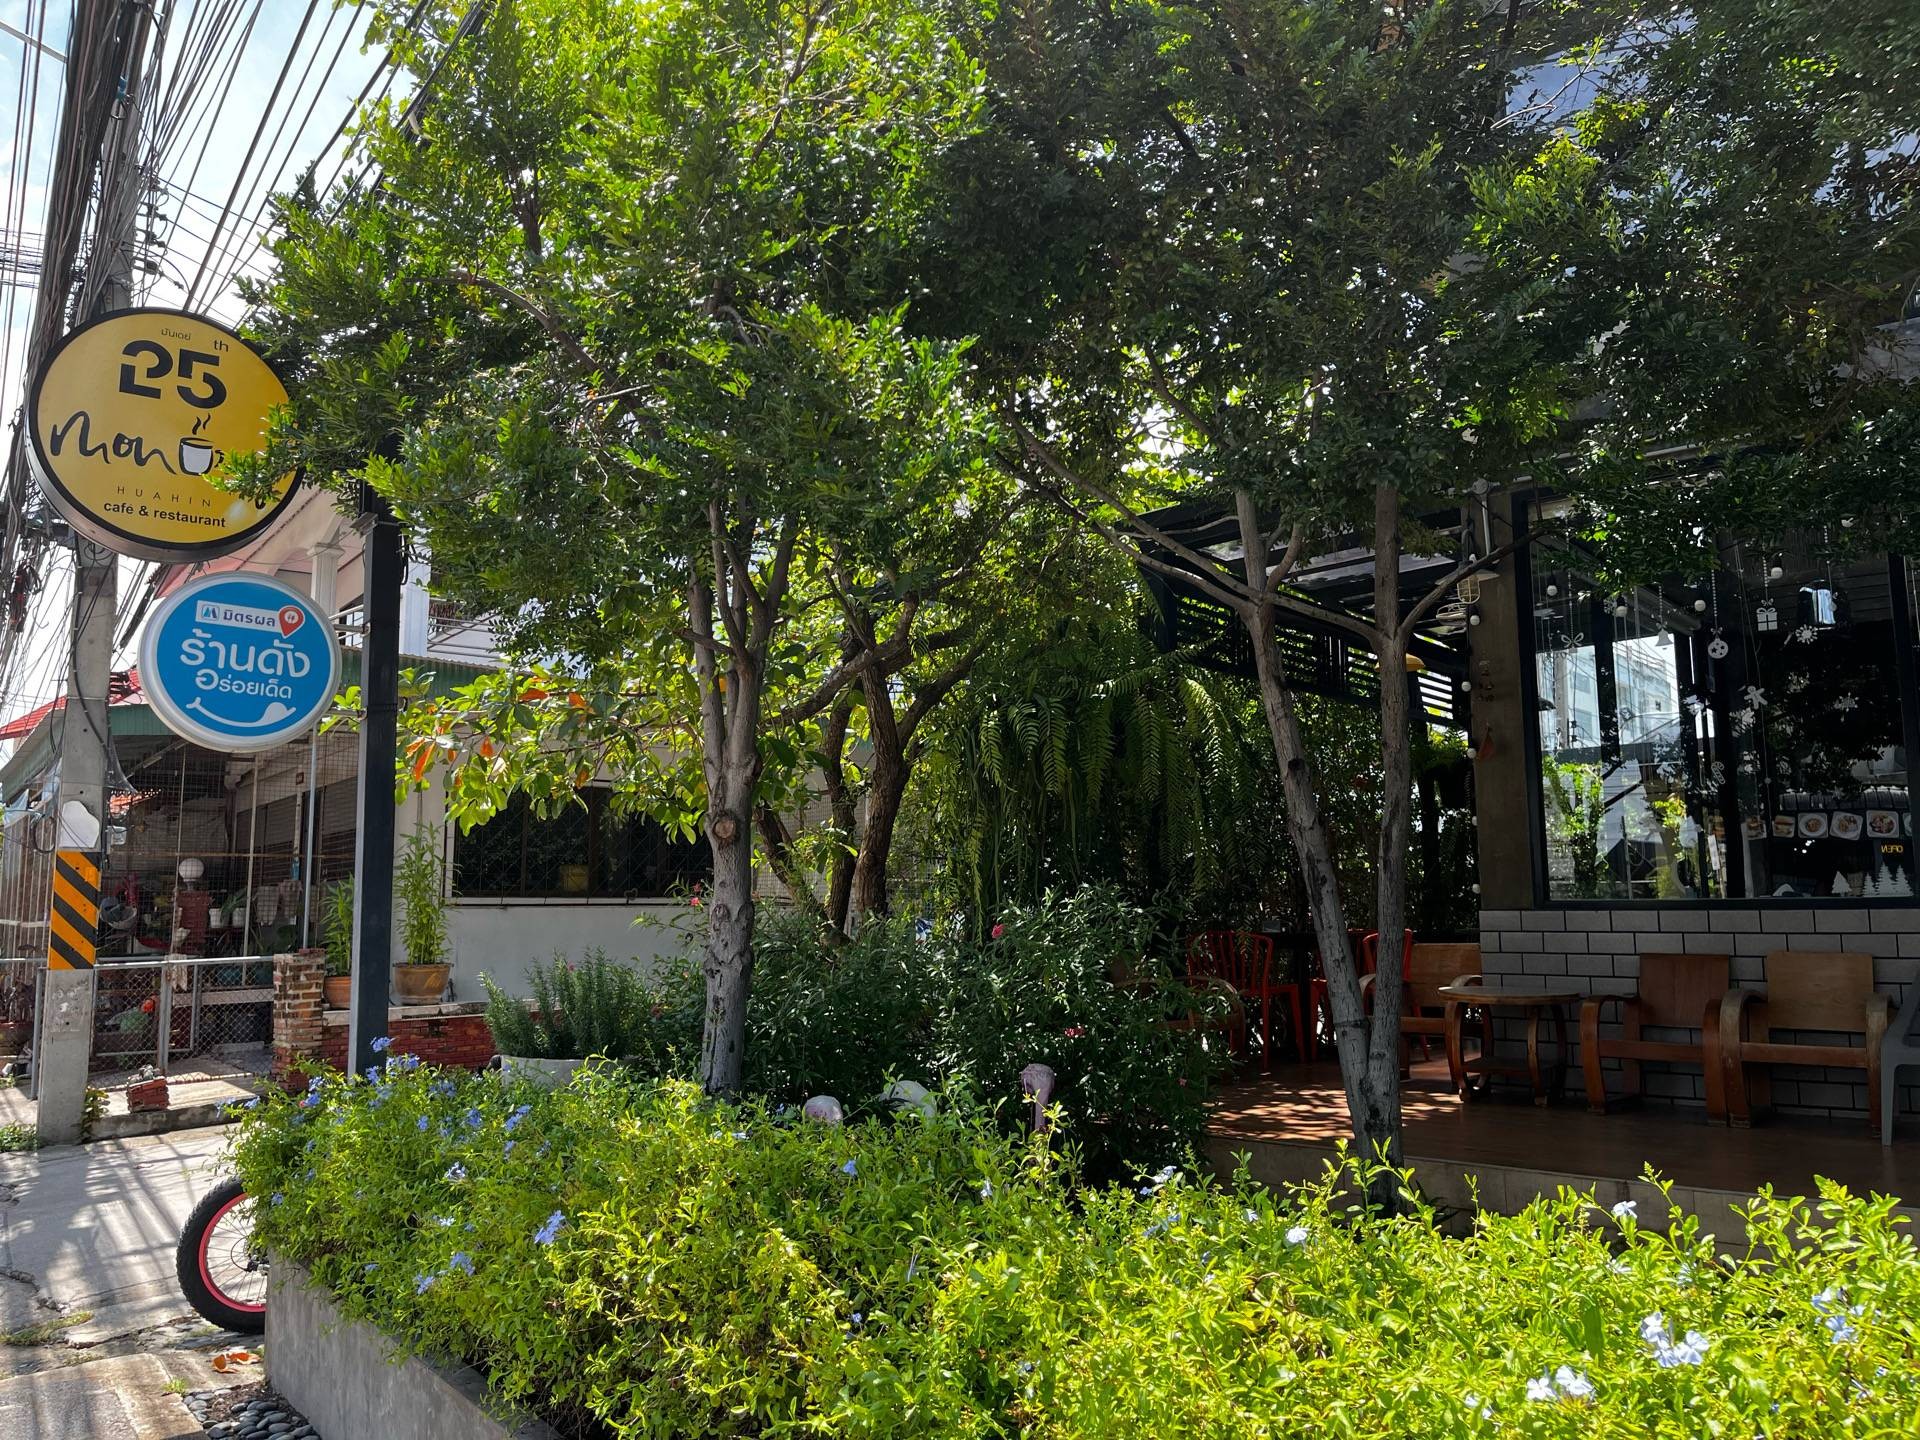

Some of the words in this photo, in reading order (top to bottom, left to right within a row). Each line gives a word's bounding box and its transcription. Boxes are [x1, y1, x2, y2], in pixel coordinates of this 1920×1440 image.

[119, 340, 227, 409] 25
[213, 340, 229, 352] th
[103, 502, 134, 515] café
[138, 505, 150, 517] &
[153, 510, 226, 528] restaurant
[223, 609, 276, 627] มิตรผล
[180, 628, 311, 678] ร้านดัง
[195, 668, 293, 699] อร่อยเด็ด
